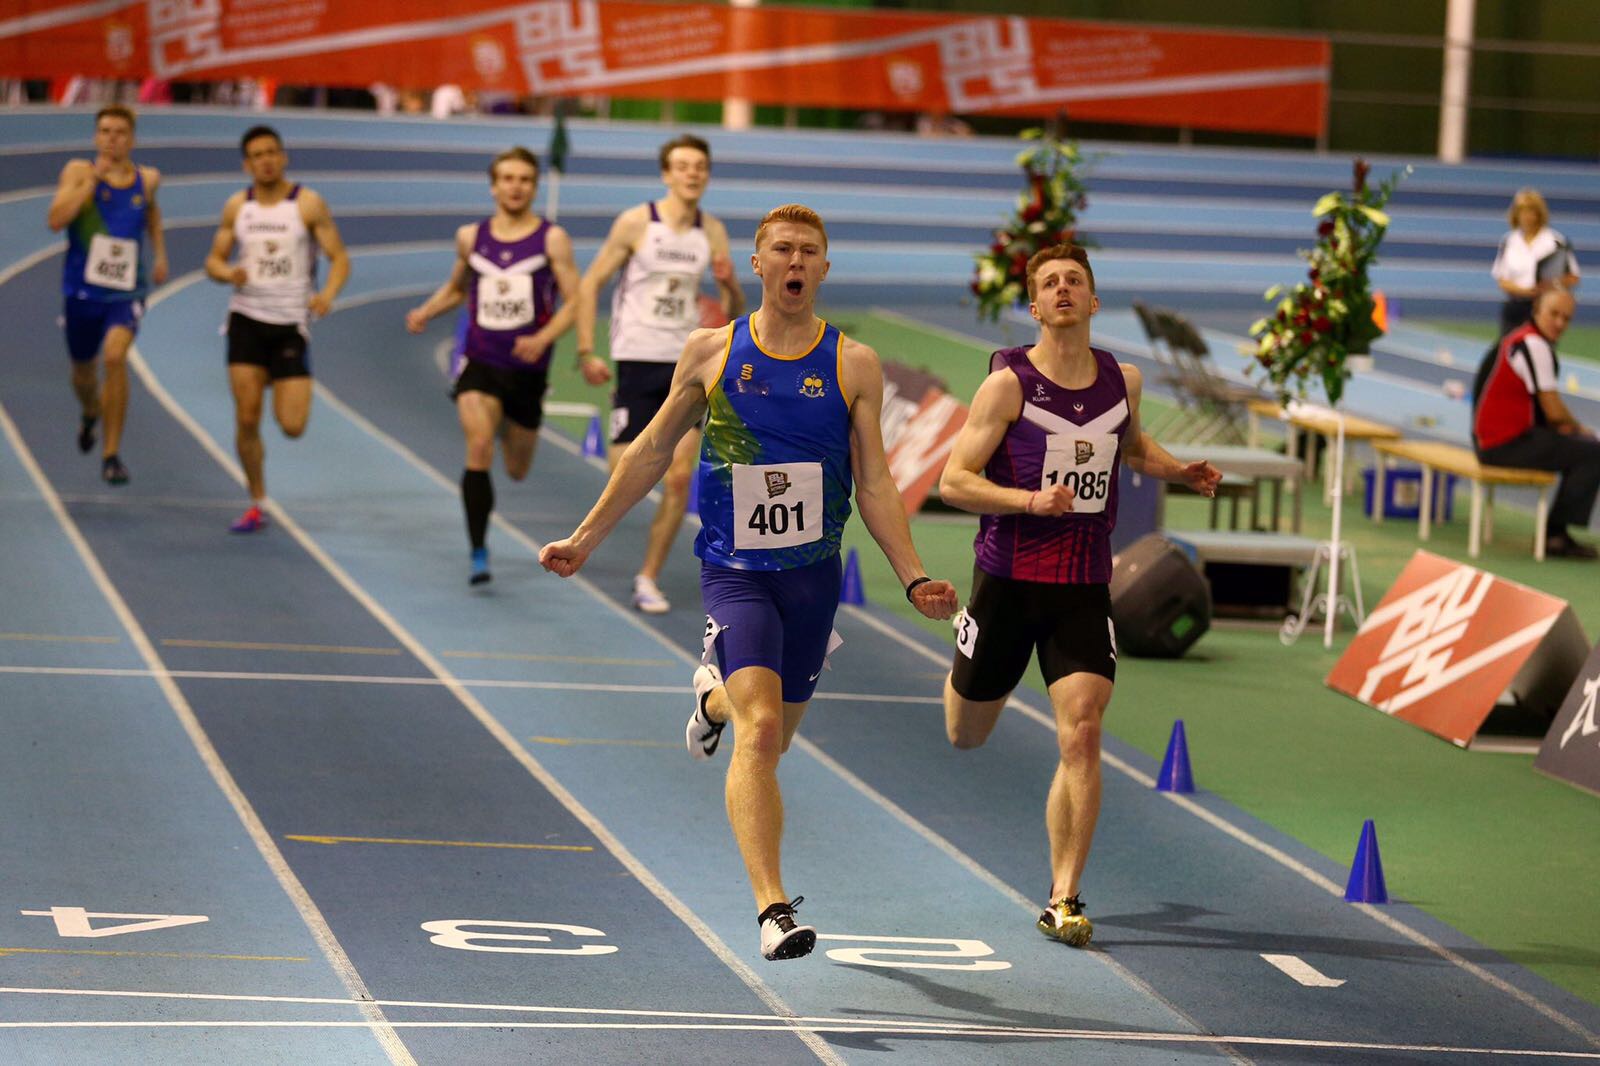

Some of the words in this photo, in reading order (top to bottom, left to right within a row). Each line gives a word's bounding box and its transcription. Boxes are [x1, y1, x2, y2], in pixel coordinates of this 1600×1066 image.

[516, 0, 598, 47] BU
[942, 15, 1031, 64] BU
[653, 296, 685, 319] 751
[1046, 470, 1108, 500] 1085
[748, 501, 805, 536] 401
[959, 617, 970, 646] 3
[20, 907, 209, 938] 4
[420, 920, 618, 956] 3
[816, 933, 1012, 971] 2
